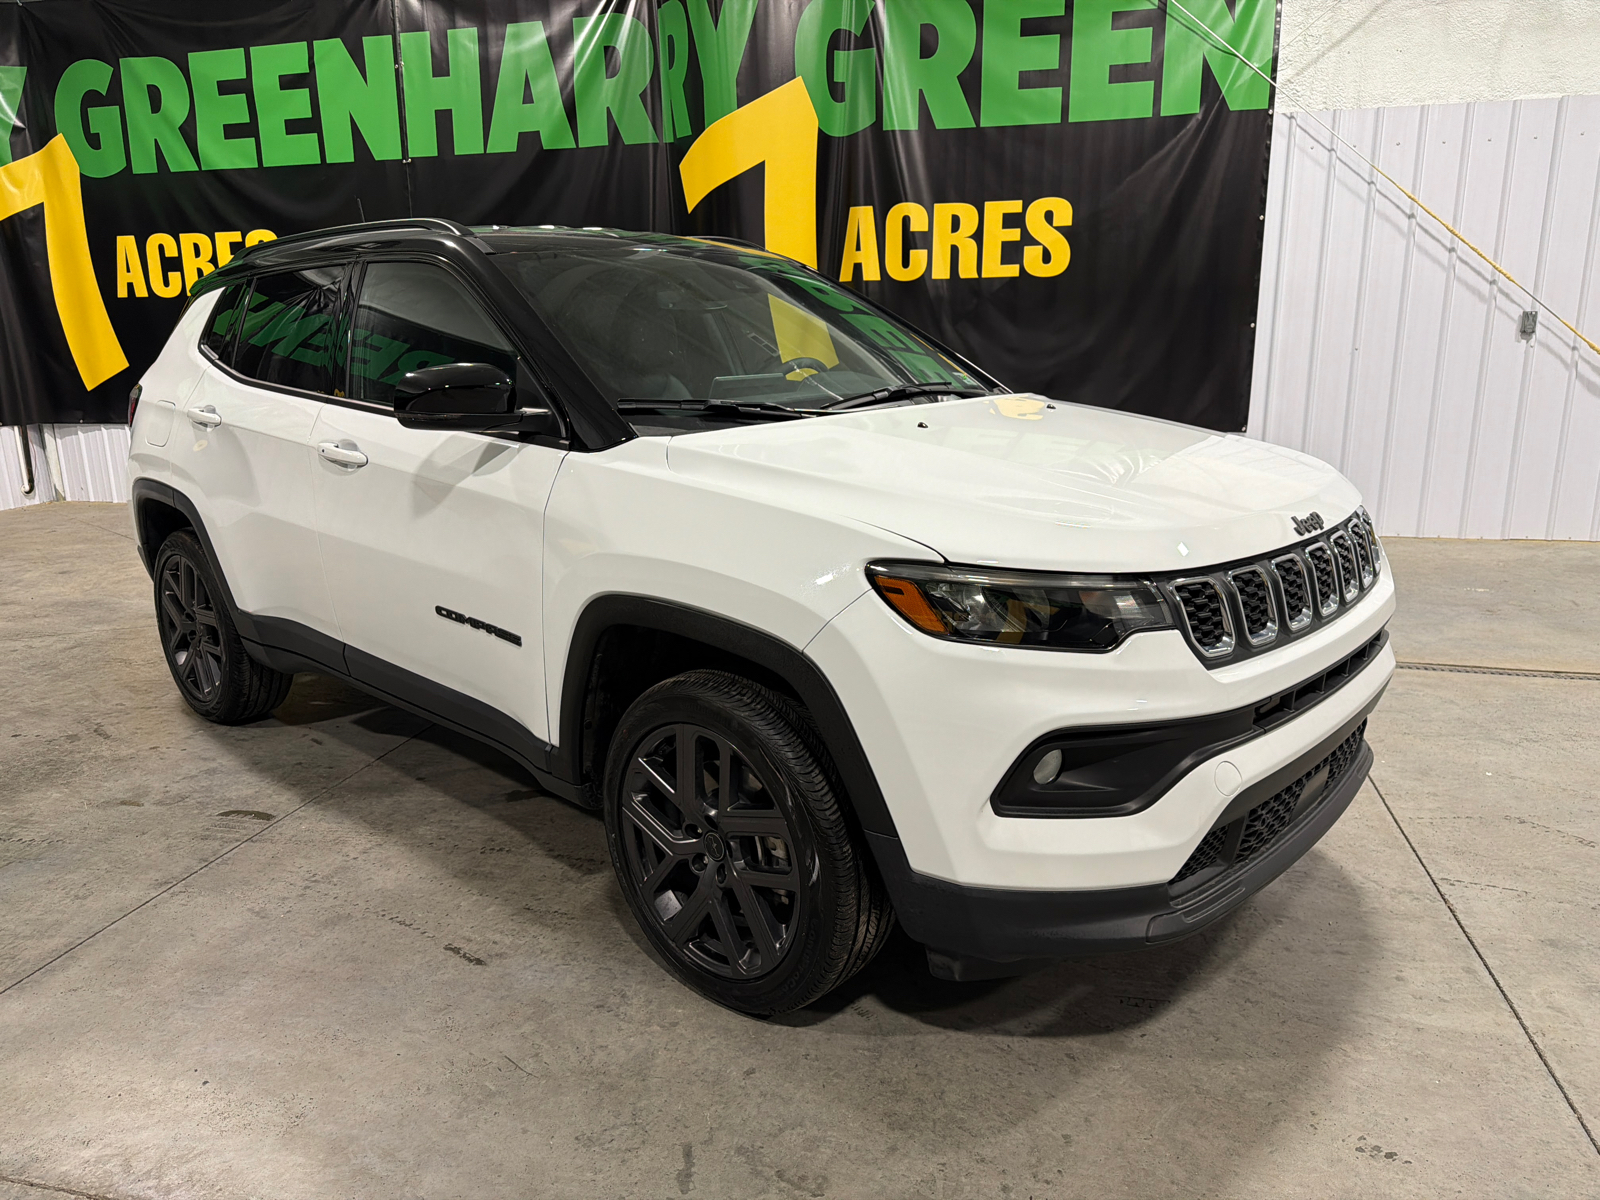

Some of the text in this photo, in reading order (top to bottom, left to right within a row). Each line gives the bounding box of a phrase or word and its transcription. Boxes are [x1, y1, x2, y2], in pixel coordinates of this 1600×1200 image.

[55, 35, 403, 178] GREEN
[795, 0, 1275, 137] GREEN
[679, 76, 818, 270] 7
[116, 229, 278, 298] ACR
[839, 197, 1073, 282] ACRES
[1290, 511, 1325, 537] Jeep
